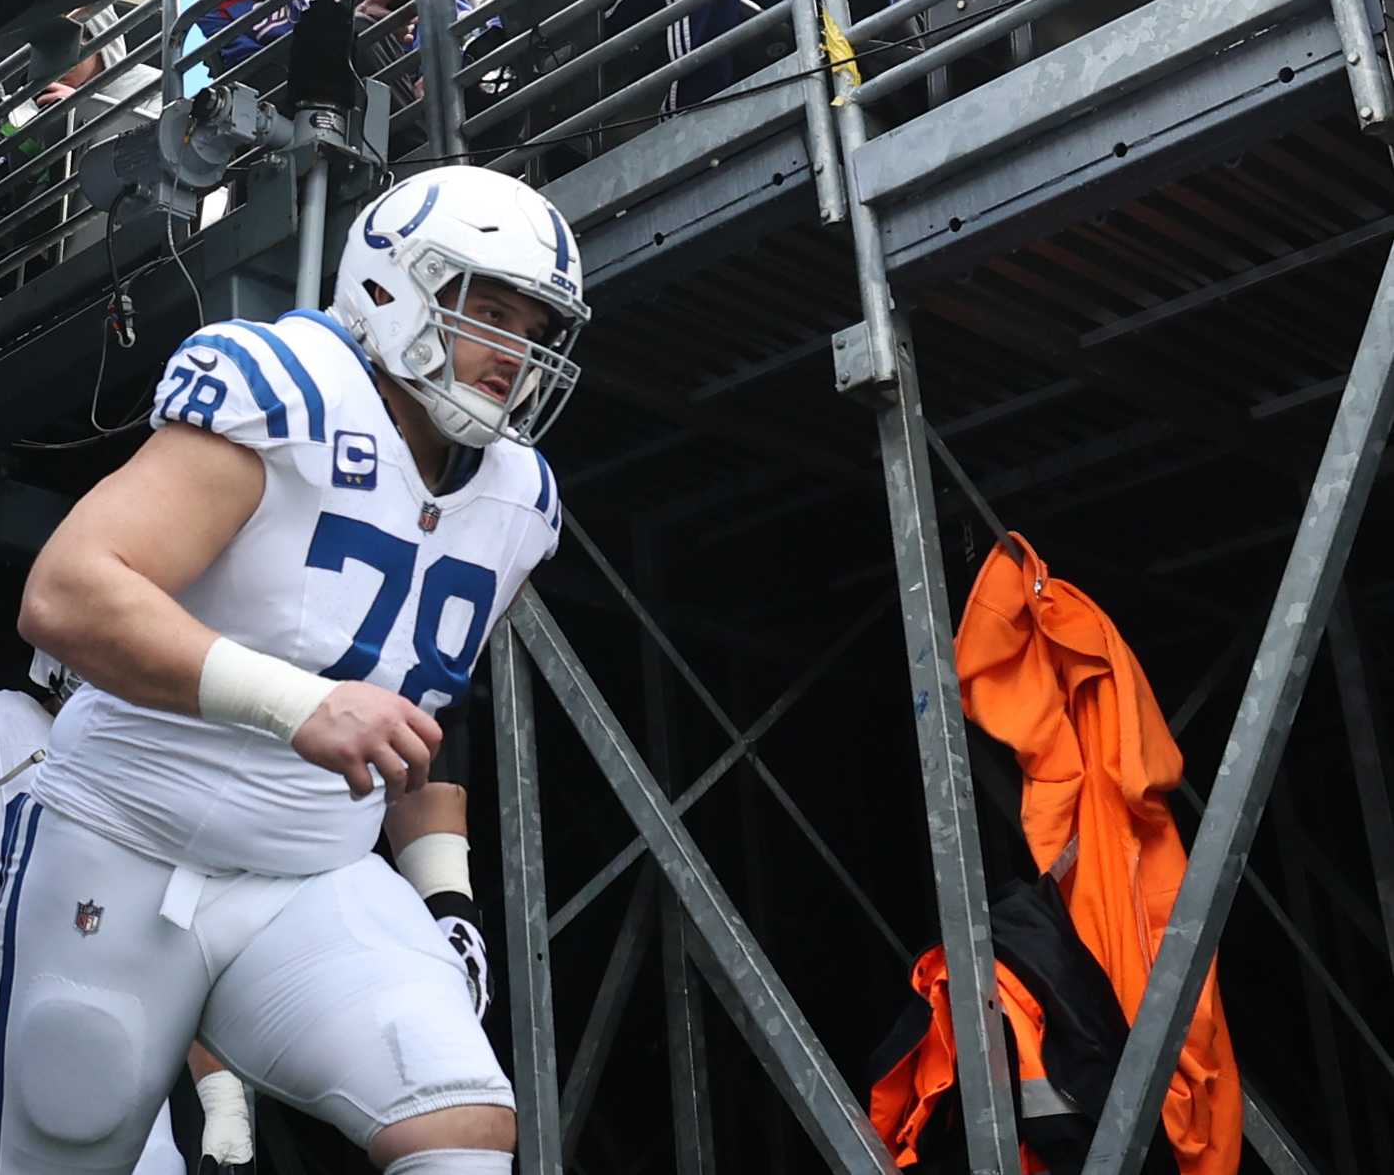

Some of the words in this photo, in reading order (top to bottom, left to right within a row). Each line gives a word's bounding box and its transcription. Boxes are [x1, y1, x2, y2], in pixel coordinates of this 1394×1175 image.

[159, 365, 229, 432] 78
[336, 433, 377, 477] C
[305, 511, 497, 712] 78
